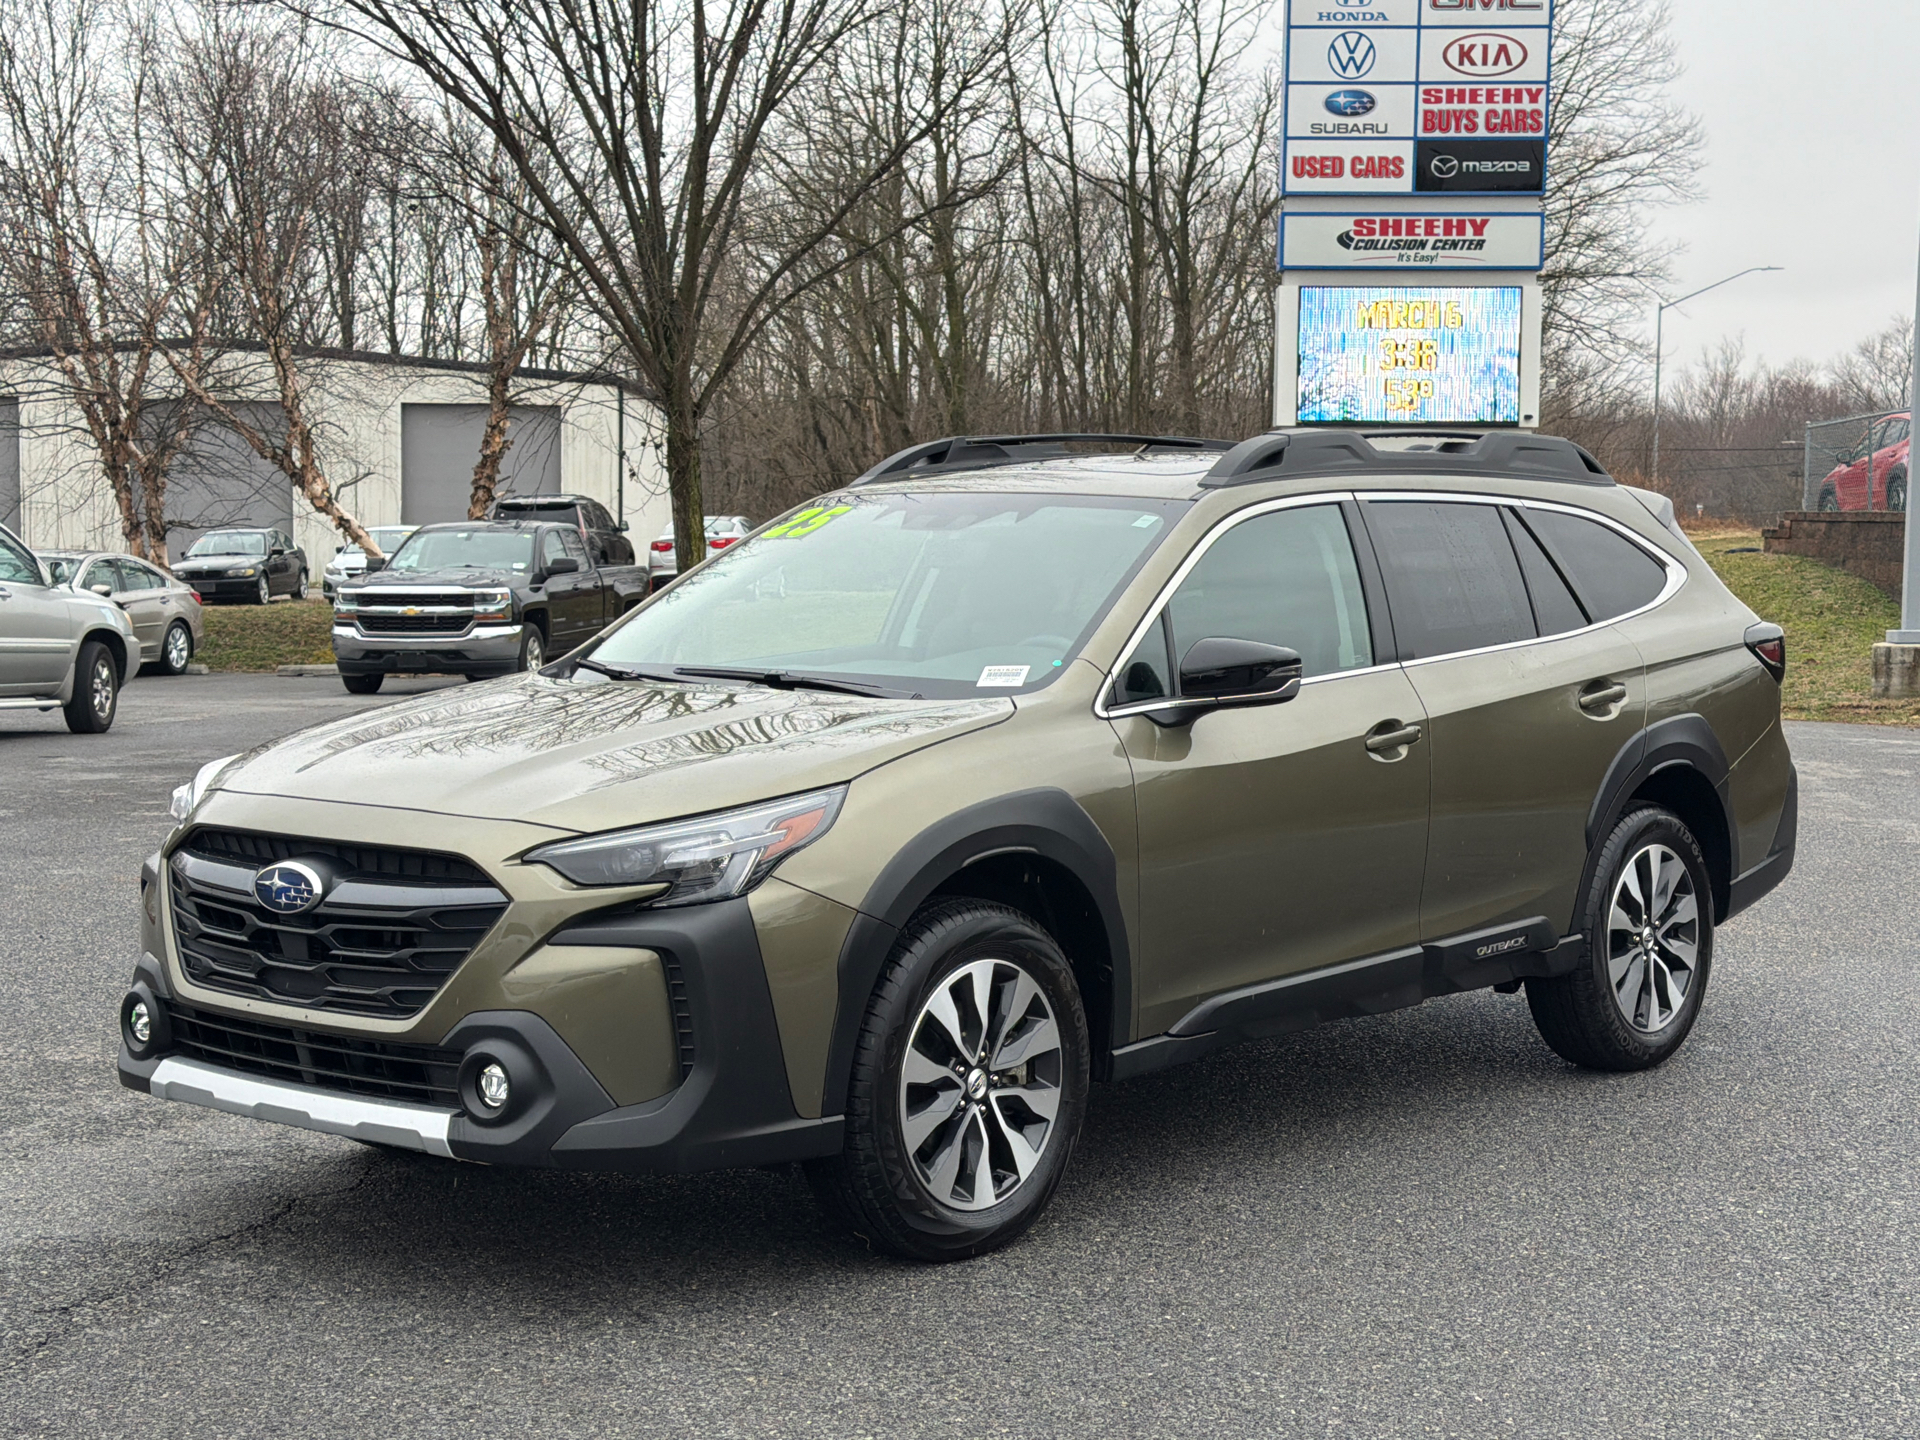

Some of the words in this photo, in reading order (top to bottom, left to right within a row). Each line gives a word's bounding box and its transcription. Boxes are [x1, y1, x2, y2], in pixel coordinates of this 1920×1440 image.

[1317, 11, 1389, 21] HONDA
[1458, 43, 1513, 66] KIA
[1422, 88, 1544, 104] SHEEHY
[1310, 123, 1388, 134] SUBARU
[1422, 109, 1479, 133] BUYS
[1484, 109, 1543, 133] CARS
[1292, 156, 1344, 178] USED
[1350, 155, 1404, 178] CARS
[1353, 218, 1490, 237] SHEEHY
[1353, 238, 1426, 250] COLLISION
[1431, 238, 1486, 250] CENTER
[1397, 252, 1411, 262] It's
[1413, 252, 1439, 264] Easy!
[1357, 300, 1441, 329] MARCH
[1444, 300, 1463, 329] 6
[760, 506, 853, 539] 25
[1476, 935, 1527, 956] OUTBACK
